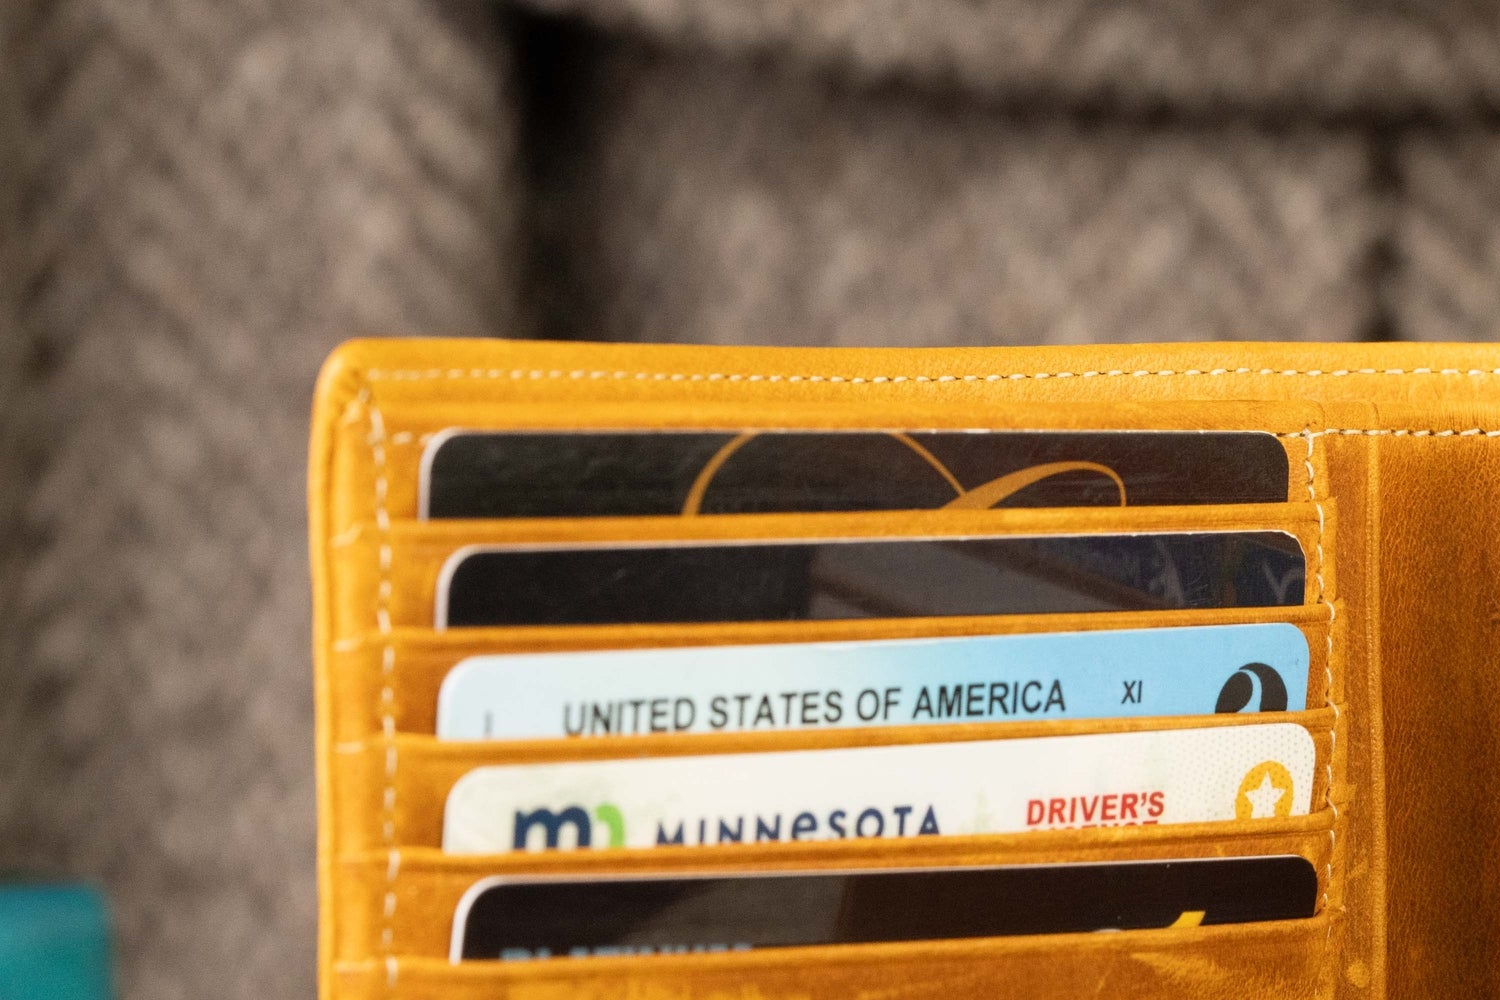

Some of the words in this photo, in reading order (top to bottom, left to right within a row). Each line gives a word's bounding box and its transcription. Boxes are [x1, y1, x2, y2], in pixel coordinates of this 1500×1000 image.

[564, 696, 696, 738] UNITED
[709, 690, 843, 729] STATES
[856, 687, 902, 722] OF
[913, 679, 1067, 719] AMERICA
[1121, 680, 1143, 704] XI
[1026, 791, 1165, 826] DRIVER'S
